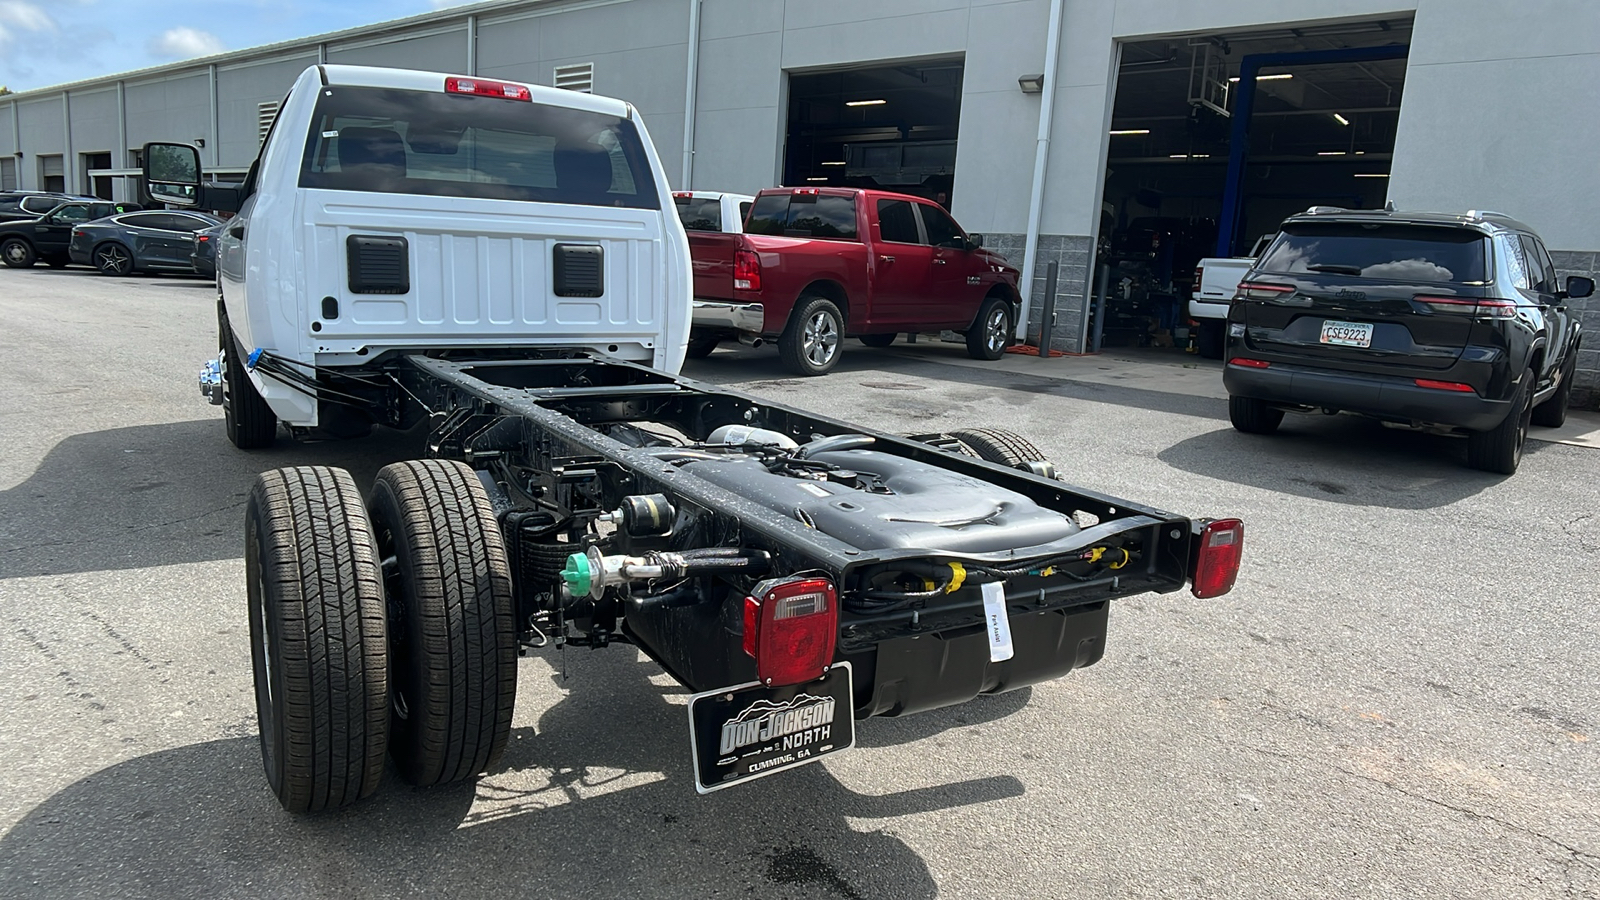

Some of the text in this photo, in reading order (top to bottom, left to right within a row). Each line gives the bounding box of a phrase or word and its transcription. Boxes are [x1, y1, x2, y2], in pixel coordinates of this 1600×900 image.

[1335, 288, 1367, 300] Jeep
[1326, 327, 1367, 341] CSE9223
[783, 725, 831, 751] NORTH
[749, 756, 795, 773] CUMMING,
[798, 749, 811, 758] GA
